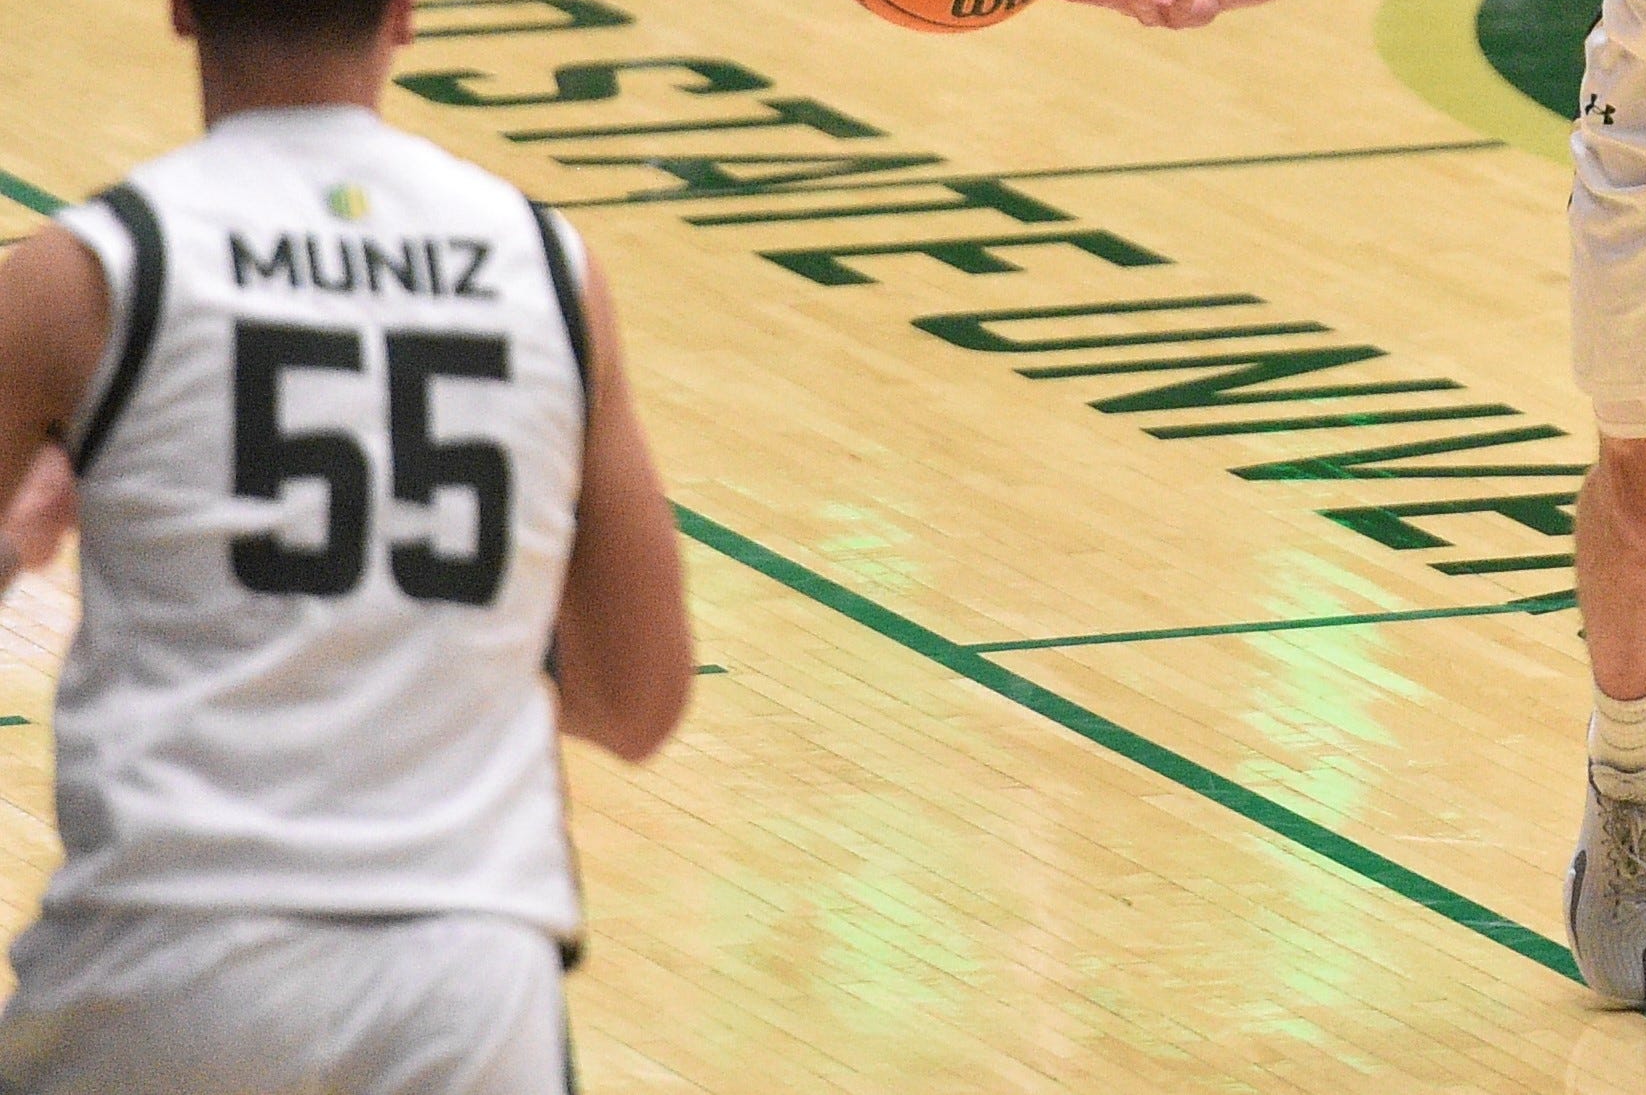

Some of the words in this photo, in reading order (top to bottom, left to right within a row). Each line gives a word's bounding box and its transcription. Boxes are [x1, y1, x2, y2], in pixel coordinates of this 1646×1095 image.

[228, 230, 501, 301] MUNIZ
[393, 56, 1178, 287] STATE
[229, 317, 511, 608] 55
